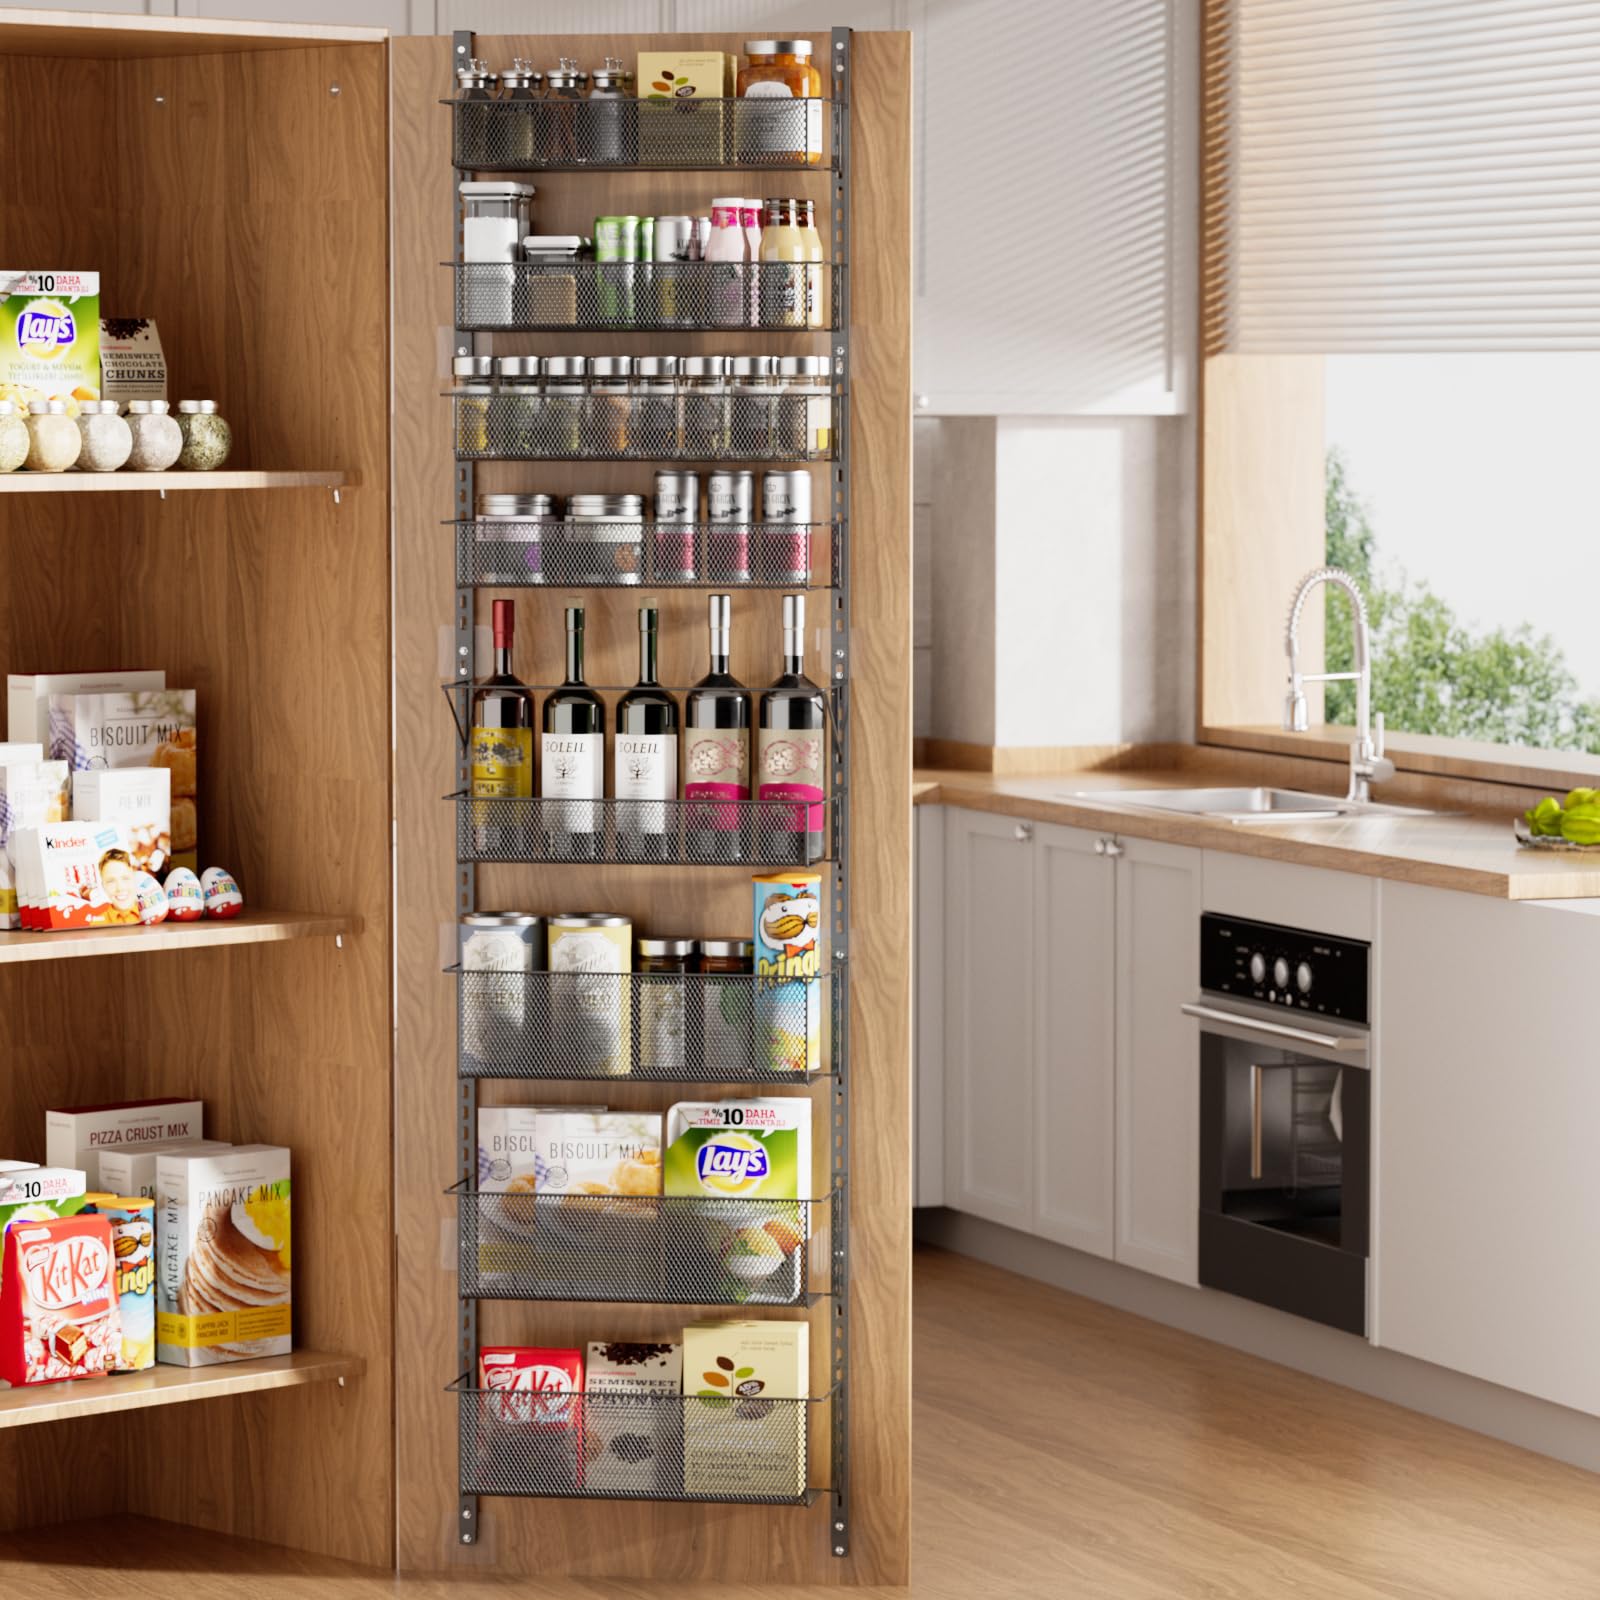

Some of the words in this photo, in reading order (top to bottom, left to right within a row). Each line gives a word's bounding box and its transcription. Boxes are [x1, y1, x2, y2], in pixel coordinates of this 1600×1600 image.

[56, 275, 81, 285] DAHA
[106, 369, 165, 379] CHUNKS
[90, 725, 149, 747] BISCUIT
[157, 723, 182, 744] MIX
[545, 741, 586, 753] SOLEIL
[619, 742, 660, 754] SOLEIL
[745, 1109, 776, 1119] DAHA
[90, 1129, 123, 1145] PIZZA
[125, 1125, 164, 1142] CRUST
[167, 1123, 190, 1138] MIX
[550, 1142, 610, 1160] BISCUIT
[619, 1144, 646, 1161] MIX
[199, 1185, 254, 1209] PANCAKE
[260, 1183, 281, 1201] MIX
[167, 1196, 179, 1224] MIX
[167, 1233, 179, 1303] PANCAKE
[588, 1378, 677, 1387] SEMISWEET
[588, 1387, 677, 1396] CHOCOLATE
